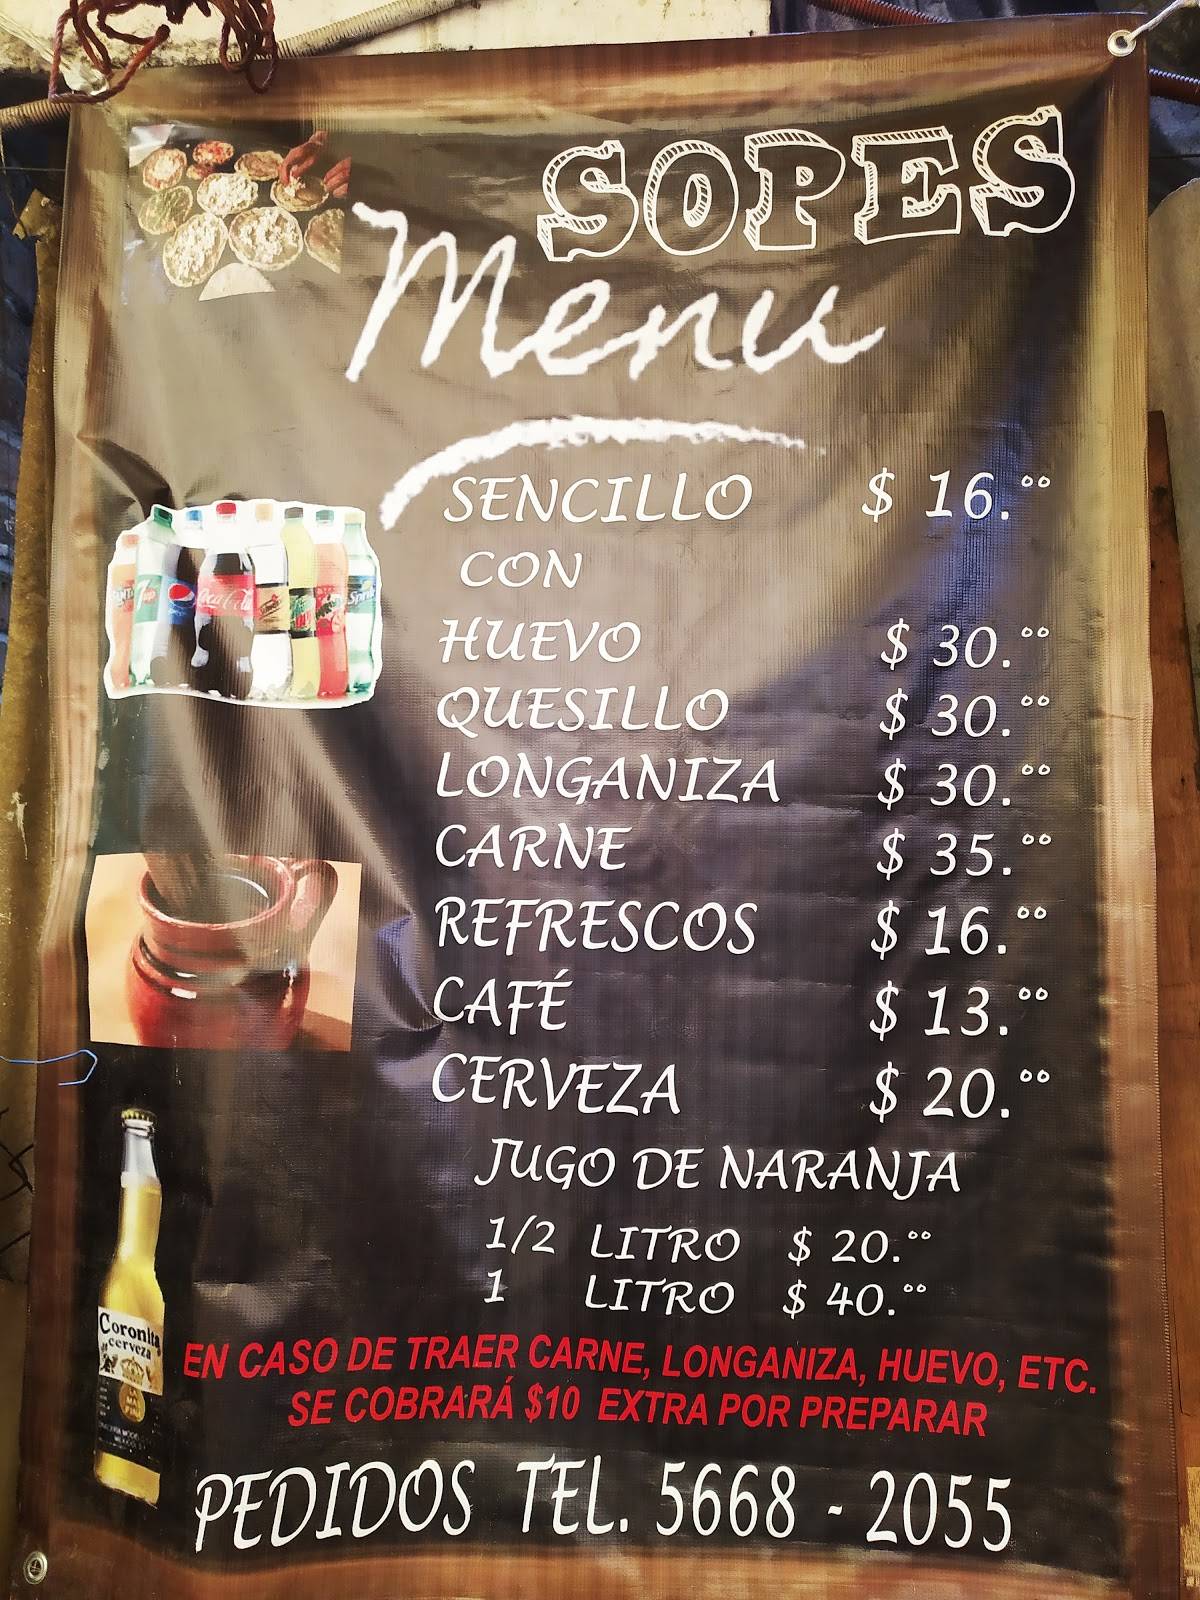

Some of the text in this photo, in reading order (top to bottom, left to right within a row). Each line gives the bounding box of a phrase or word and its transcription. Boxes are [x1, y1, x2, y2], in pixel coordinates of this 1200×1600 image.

[536, 104, 1076, 262] SOPES
[345, 200, 886, 382] Menu
[443, 473, 753, 523] SENCILLO
[460, 549, 583, 589] CON
[438, 616, 641, 663] HUEVO
[436, 685, 729, 739] QUESILLO
[436, 751, 780, 805] LONGANIZA
[435, 822, 633, 872] CARNE
[435, 896, 758, 956] REFRESCOS
[433, 968, 573, 1035] CAFÉ
[432, 1053, 680, 1116] CERVEZA
[473, 1138, 961, 1201] JUGO DE NARANJA
[485, 1215, 555, 1254] 1/2
[590, 1224, 740, 1263] LITRO
[484, 1268, 505, 1303] 1
[585, 1274, 735, 1315] LITRO
[99, 1312, 161, 1348] Coronita
[108, 1337, 151, 1360] cerveza
[183, 1333, 1097, 1394] EN CASO DE TRAER CARNE, LONGANIZA, HUEVO, ETC.
[287, 1375, 988, 1437] SE COBRARÁ $10 EXTRA POR PREPARAR
[195, 1459, 475, 1552] PEDIDOS
[516, 1453, 628, 1535] TEL.
[656, 1461, 795, 1538] 5668
[866, 1470, 1011, 1552] 2055
